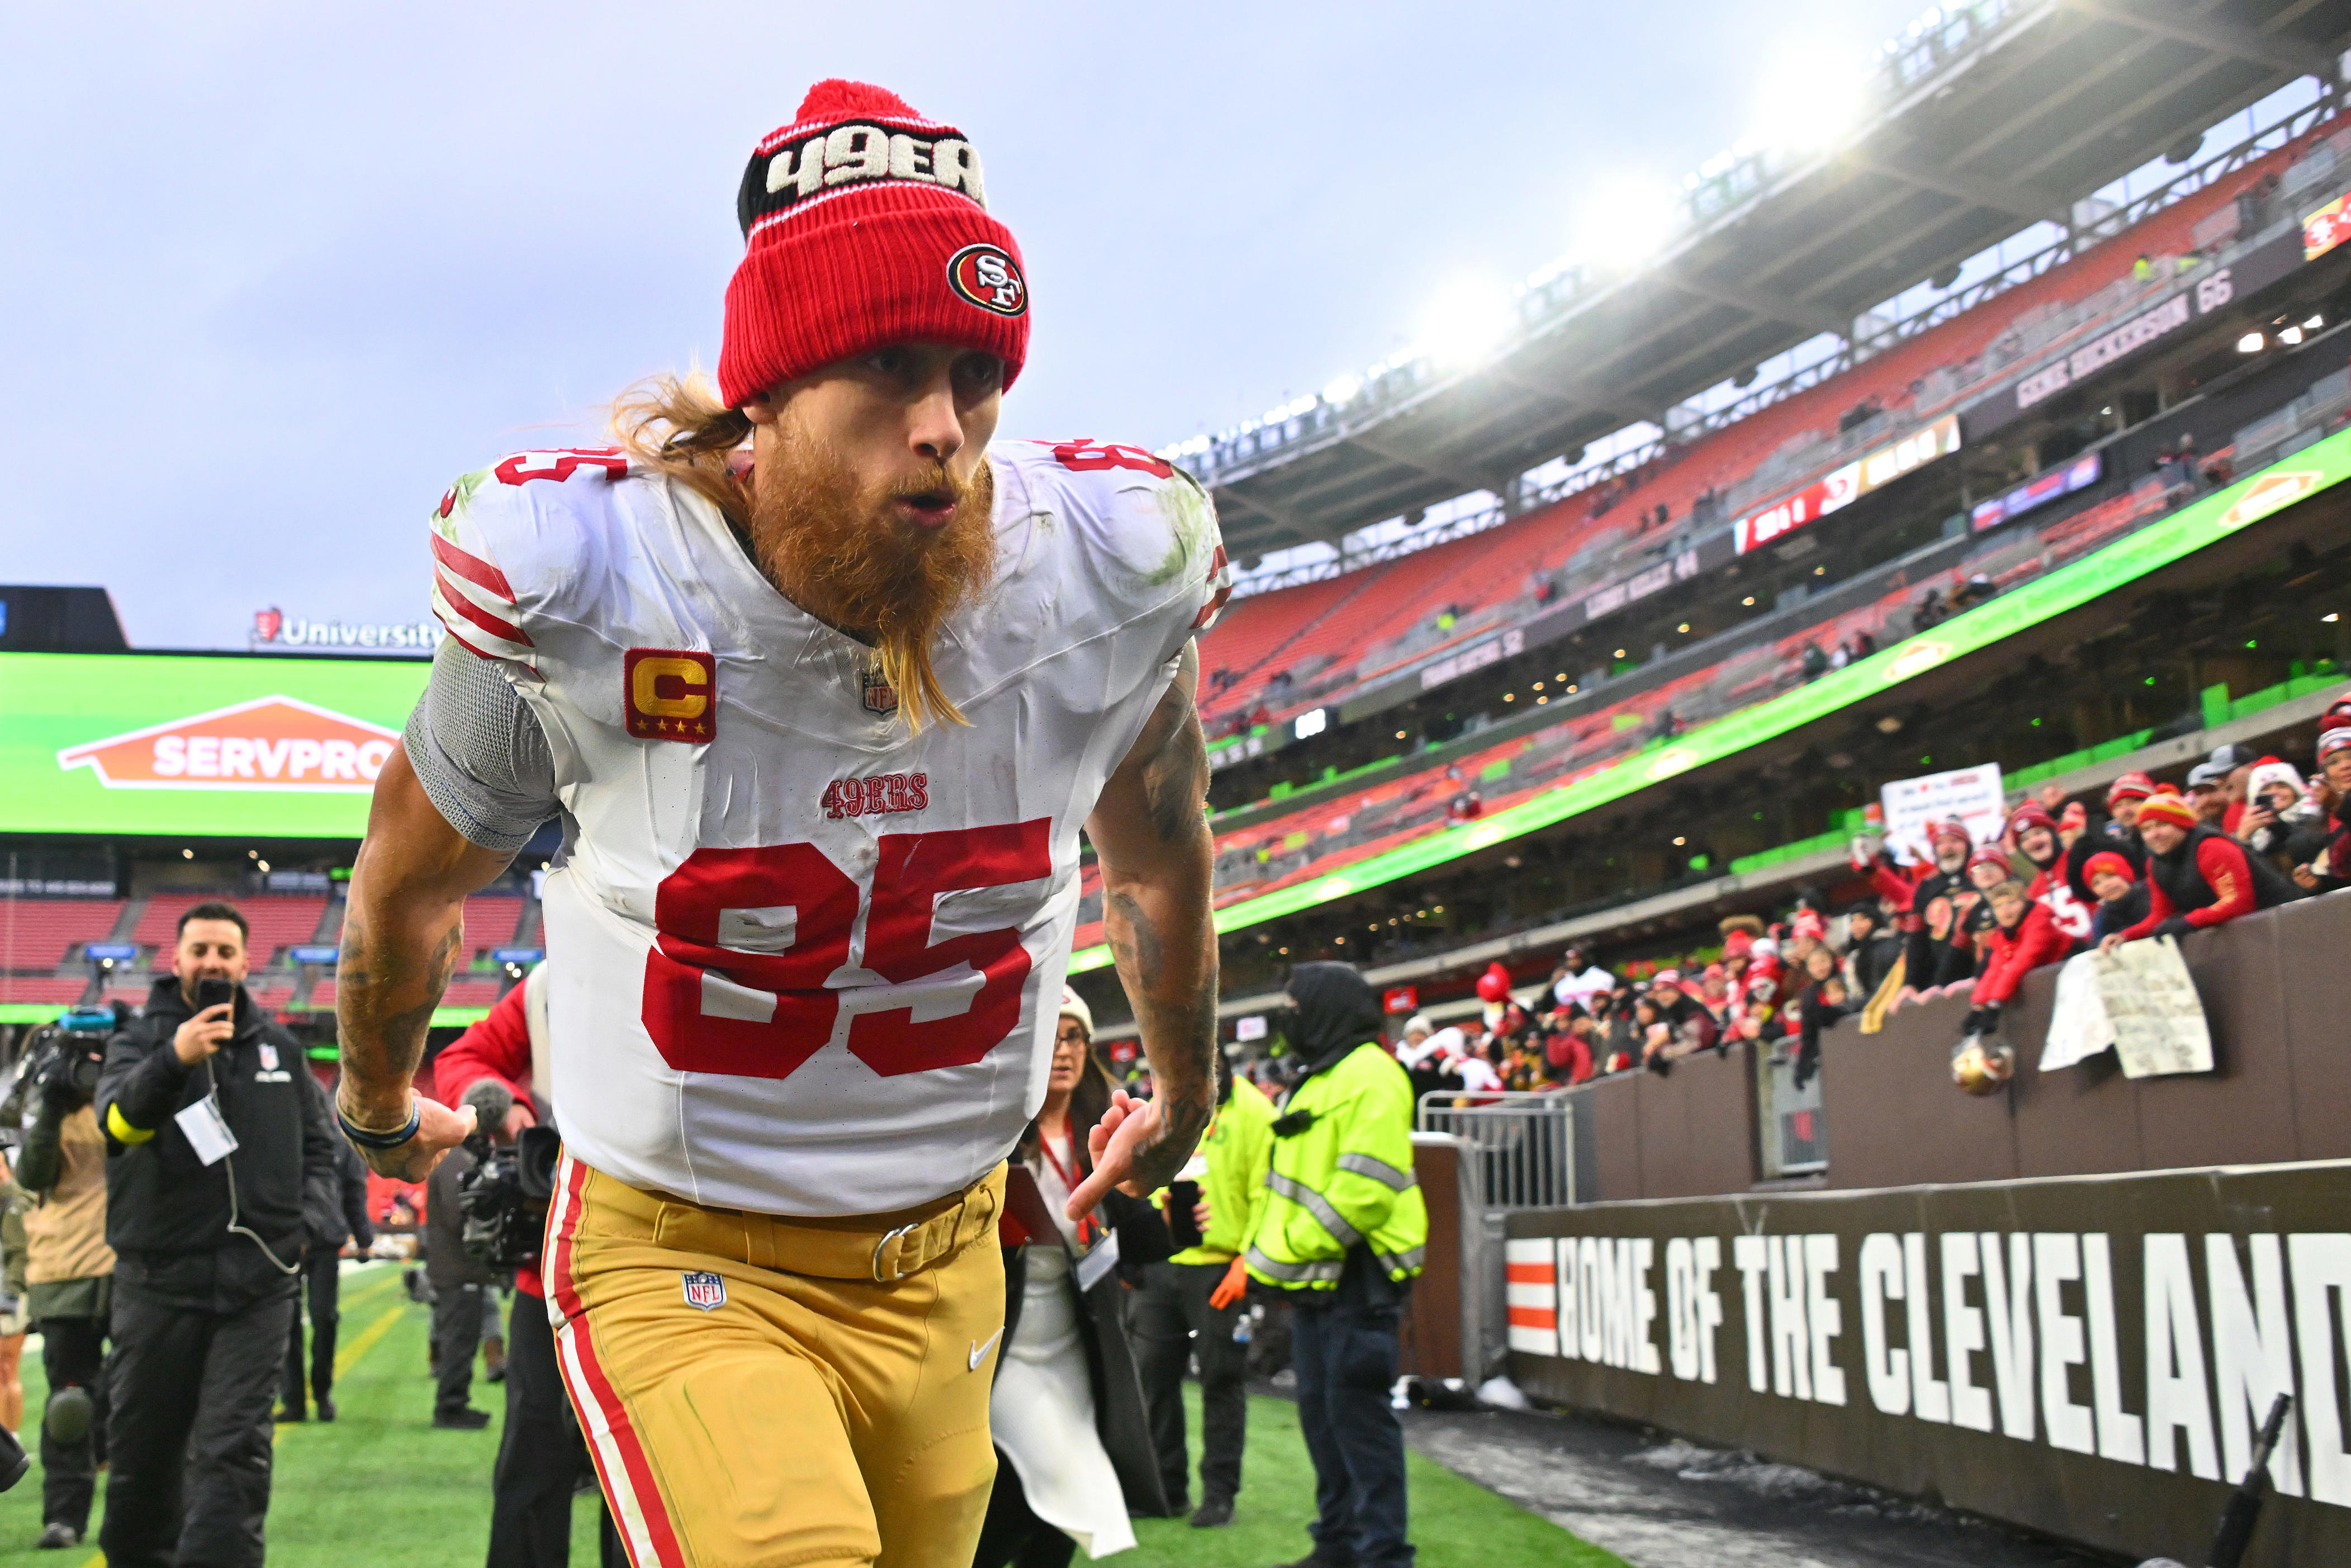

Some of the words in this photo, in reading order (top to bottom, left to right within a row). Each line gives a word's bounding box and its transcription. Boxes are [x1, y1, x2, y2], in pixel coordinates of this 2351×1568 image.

[633, 657, 708, 720] C
[153, 736, 395, 779] SERVPRO
[822, 773, 928, 819] 49ERS
[641, 817, 1052, 1079] 85
[690, 1285, 720, 1303] NFL
[1557, 1237, 1662, 1375] HOME
[1666, 1236, 1723, 1385] OF
[1734, 1233, 1847, 1407] THE
